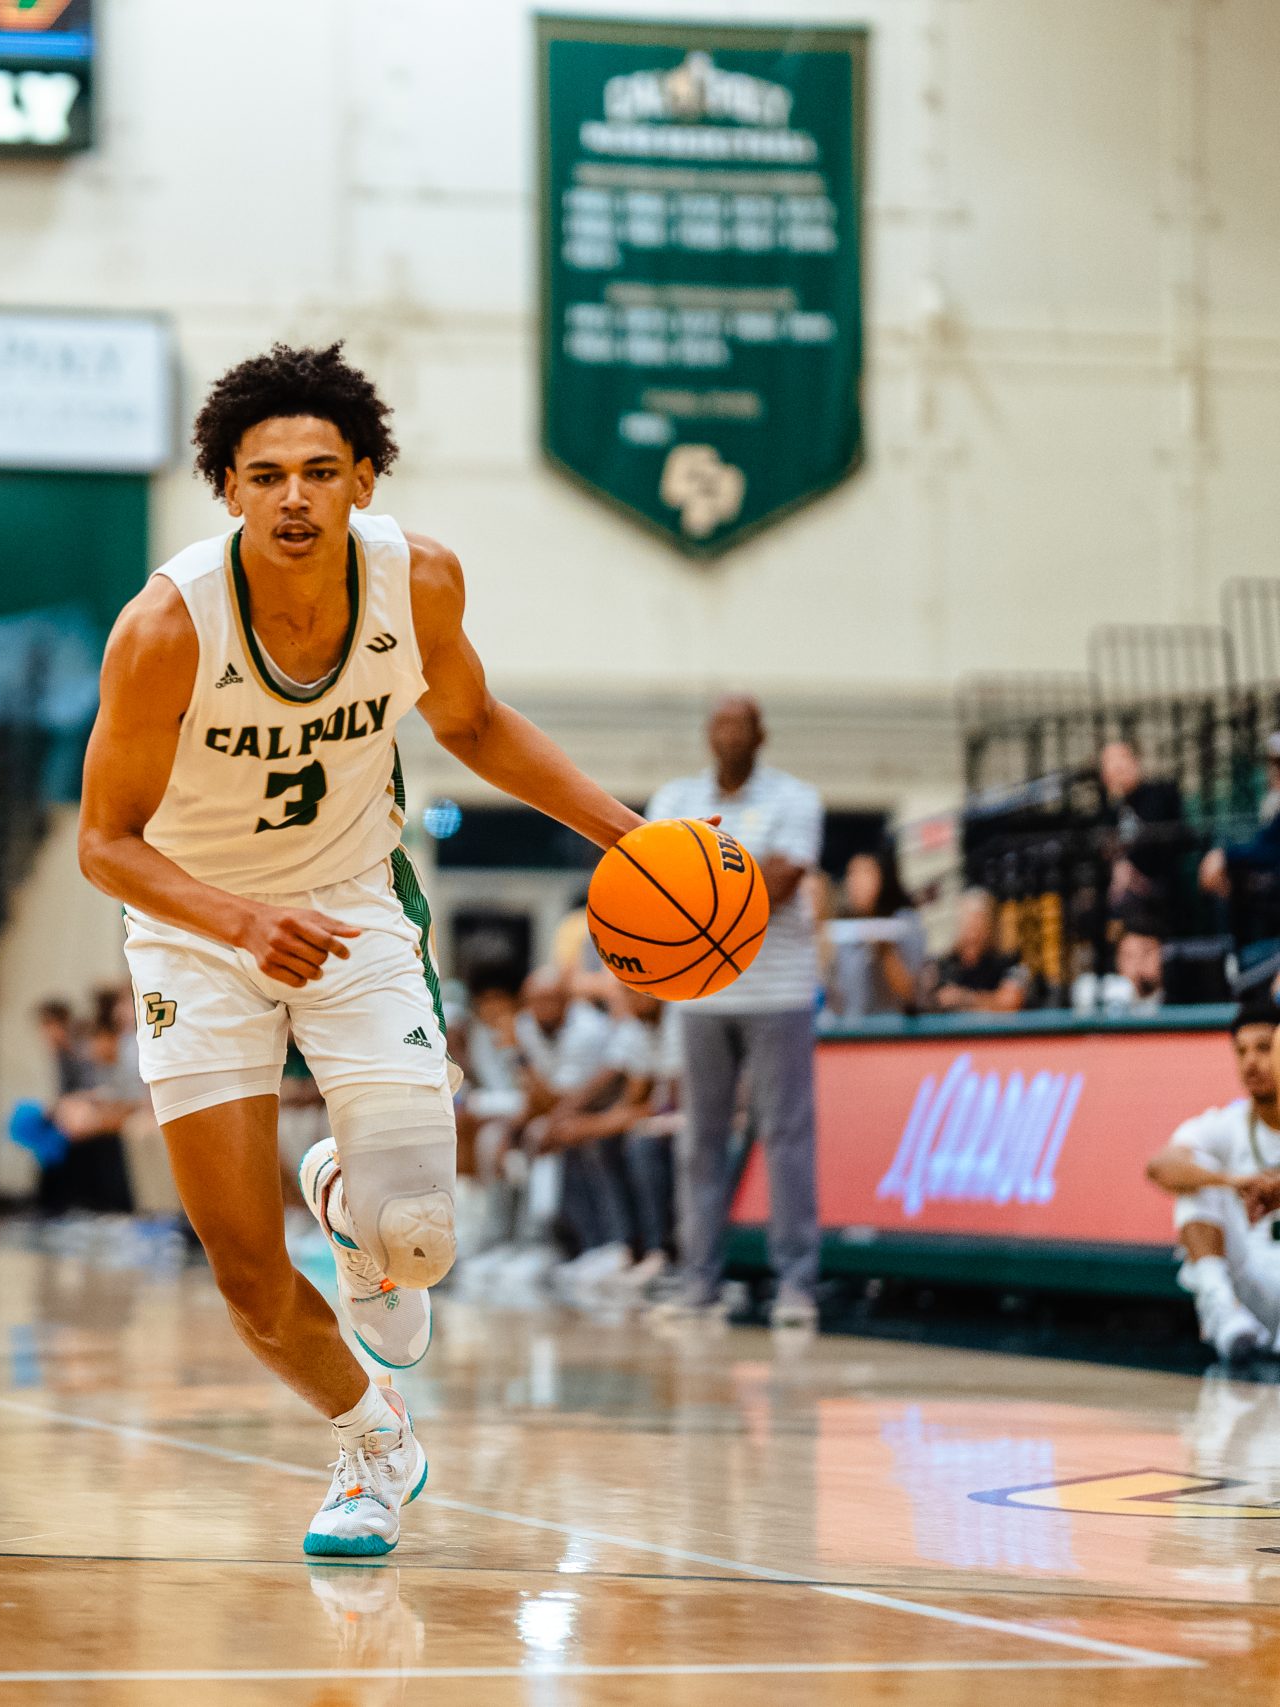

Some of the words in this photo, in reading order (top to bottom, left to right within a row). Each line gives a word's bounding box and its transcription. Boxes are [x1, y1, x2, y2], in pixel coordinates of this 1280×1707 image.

[215, 676, 244, 689] adidas
[205, 725, 291, 760] CAL
[297, 694, 393, 757] POLY
[254, 758, 328, 834] 3
[403, 1037, 433, 1050] adidas
